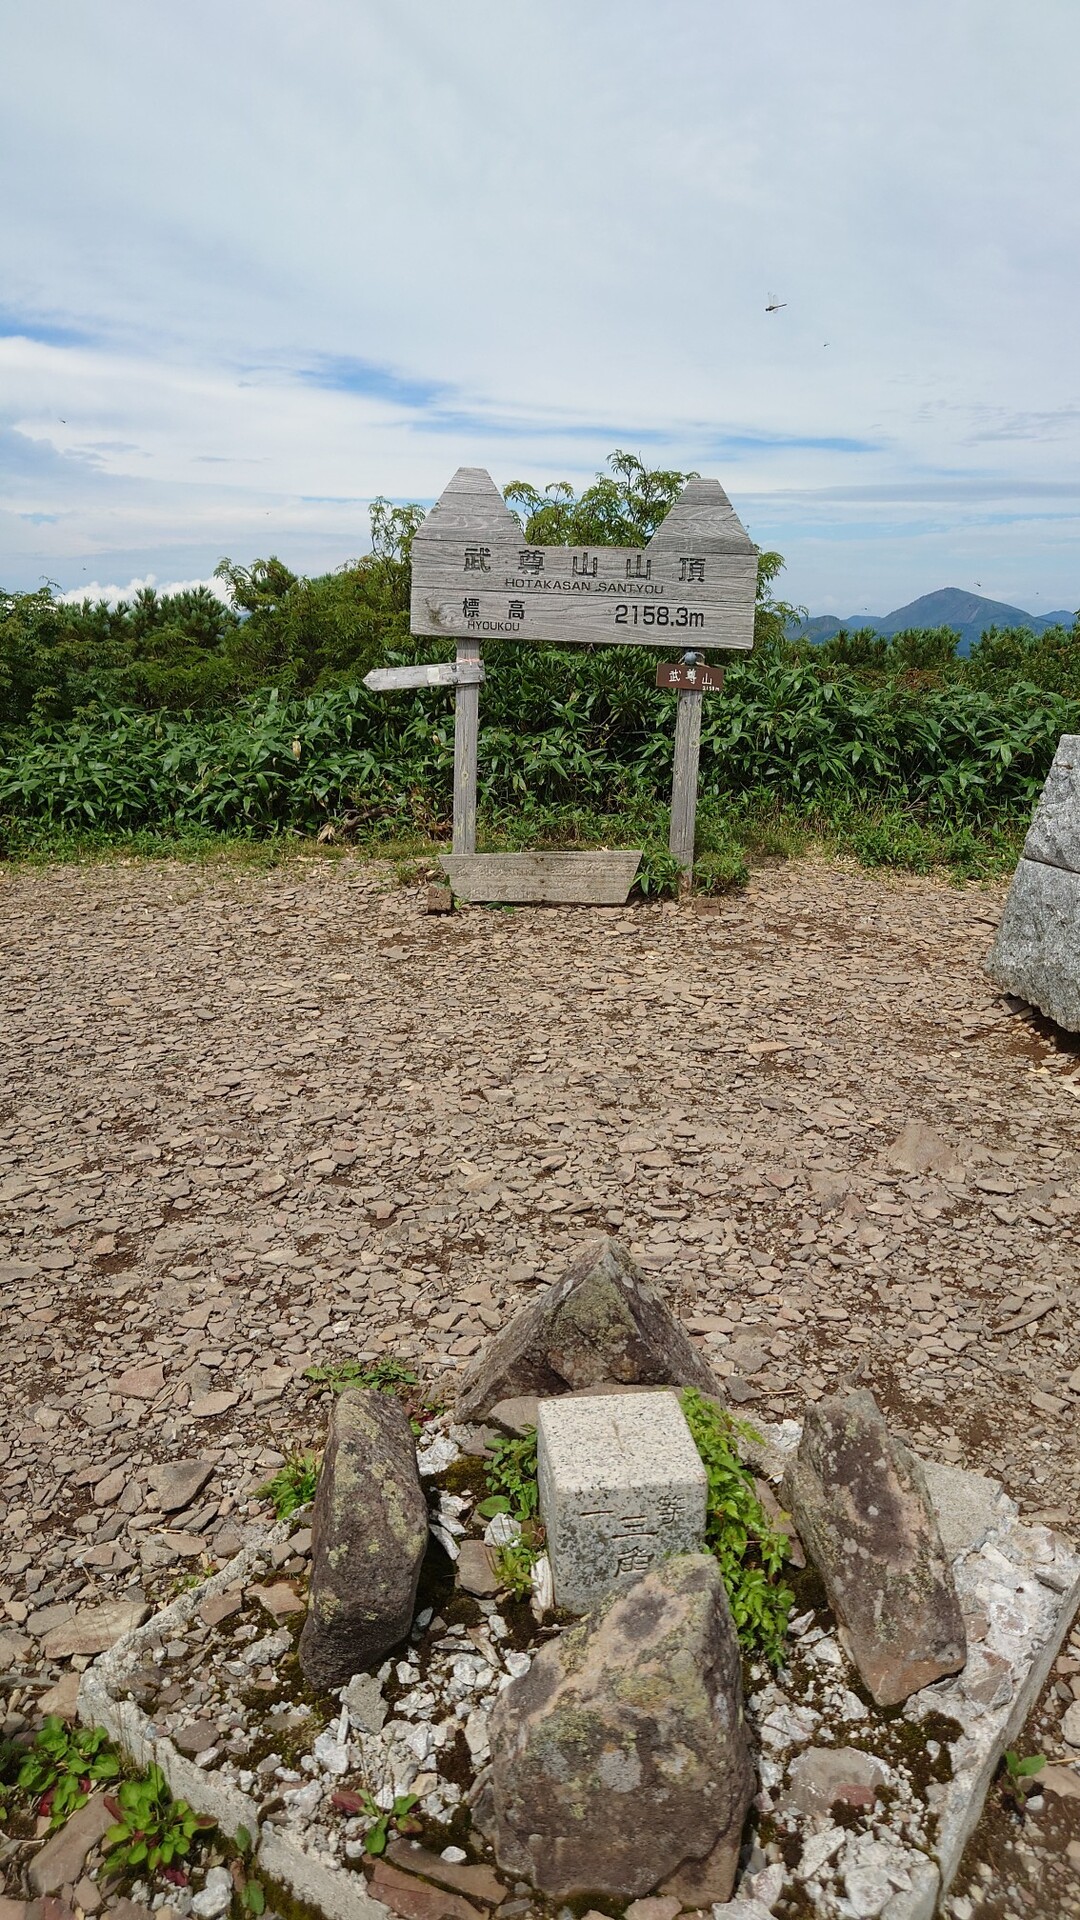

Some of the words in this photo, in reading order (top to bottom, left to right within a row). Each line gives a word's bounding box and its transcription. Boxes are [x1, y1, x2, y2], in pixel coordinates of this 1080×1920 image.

[463, 547, 706, 583] 武尊山山頂
[504, 577, 591, 592] HOTAKASAN
[462, 597, 526, 620] 標高
[614, 604, 705, 628] 2158.3m
[467, 620, 520, 632] HYOUKOU
[668, 668, 713, 685] 武尊山
